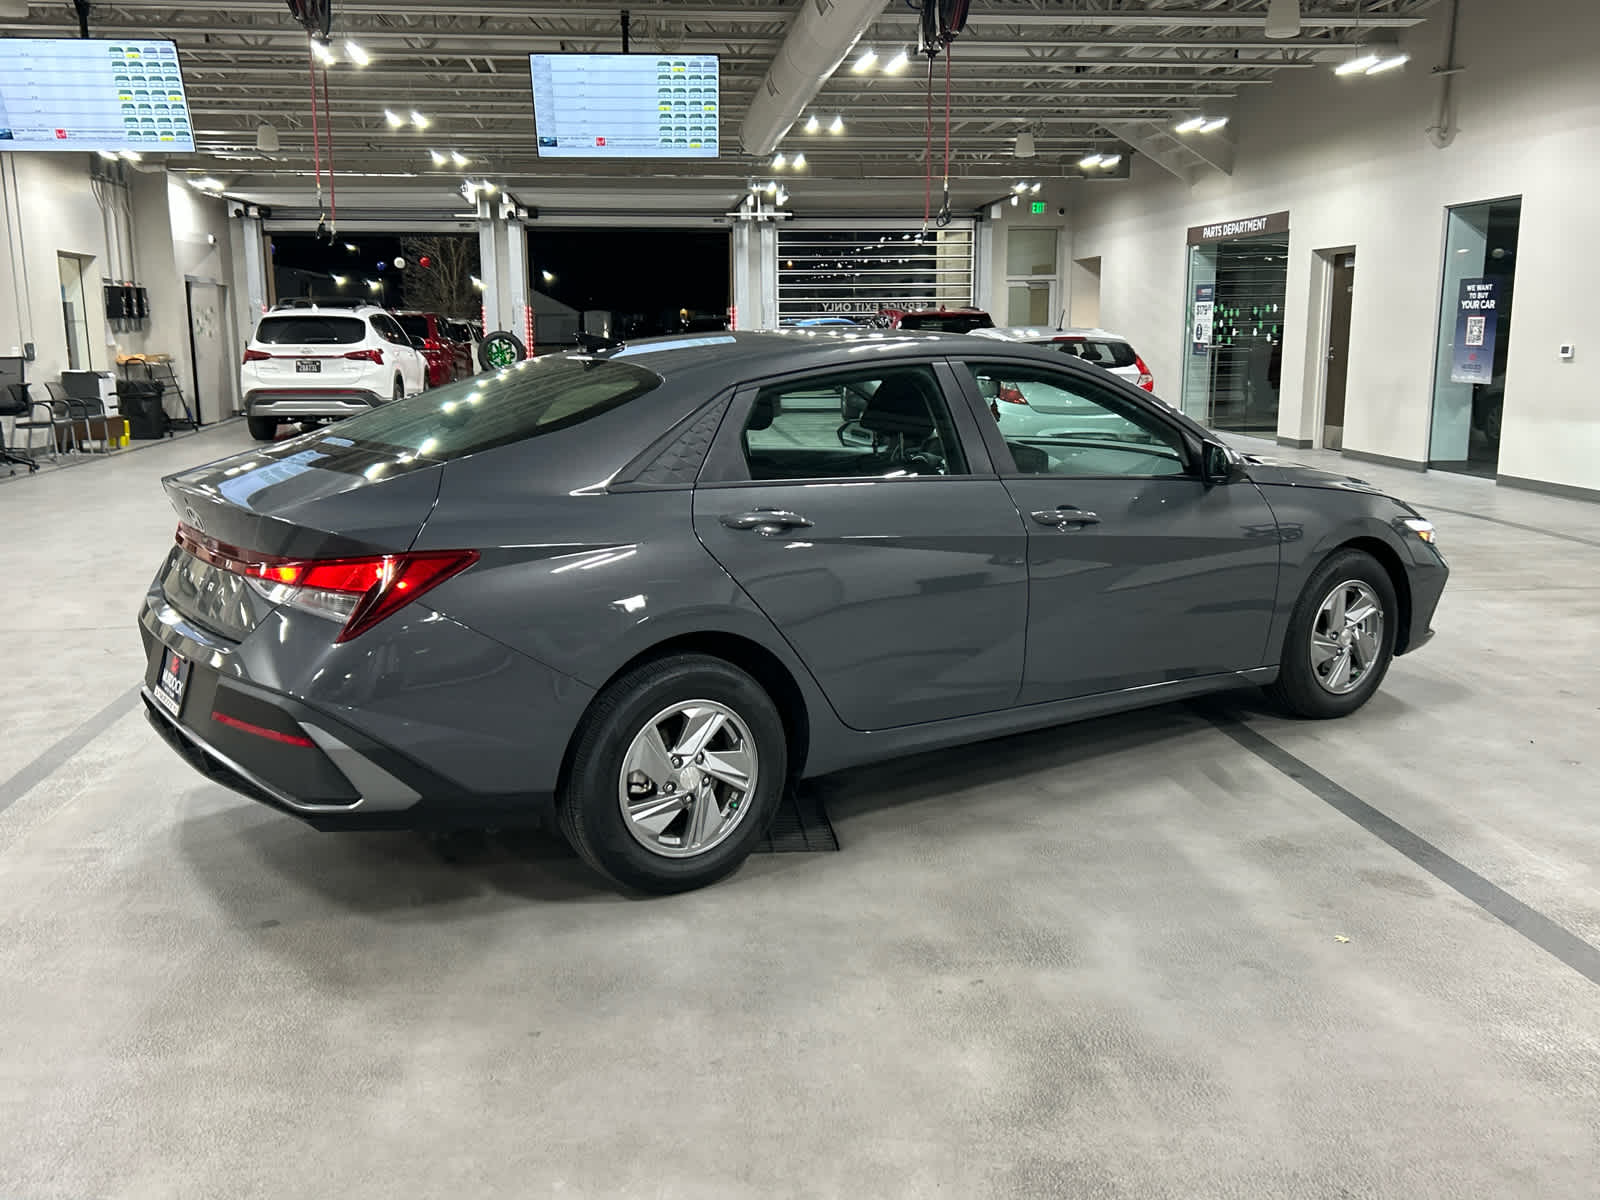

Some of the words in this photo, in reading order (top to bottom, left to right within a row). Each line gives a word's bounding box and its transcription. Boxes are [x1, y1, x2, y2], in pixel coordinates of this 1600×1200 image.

[1032, 202, 1045, 214] EXIT
[1203, 226, 1222, 238] PARTS
[1223, 217, 1267, 235] DEPARTMENT
[1461, 300, 1480, 309] YOUR
[1481, 300, 1496, 309] CAR
